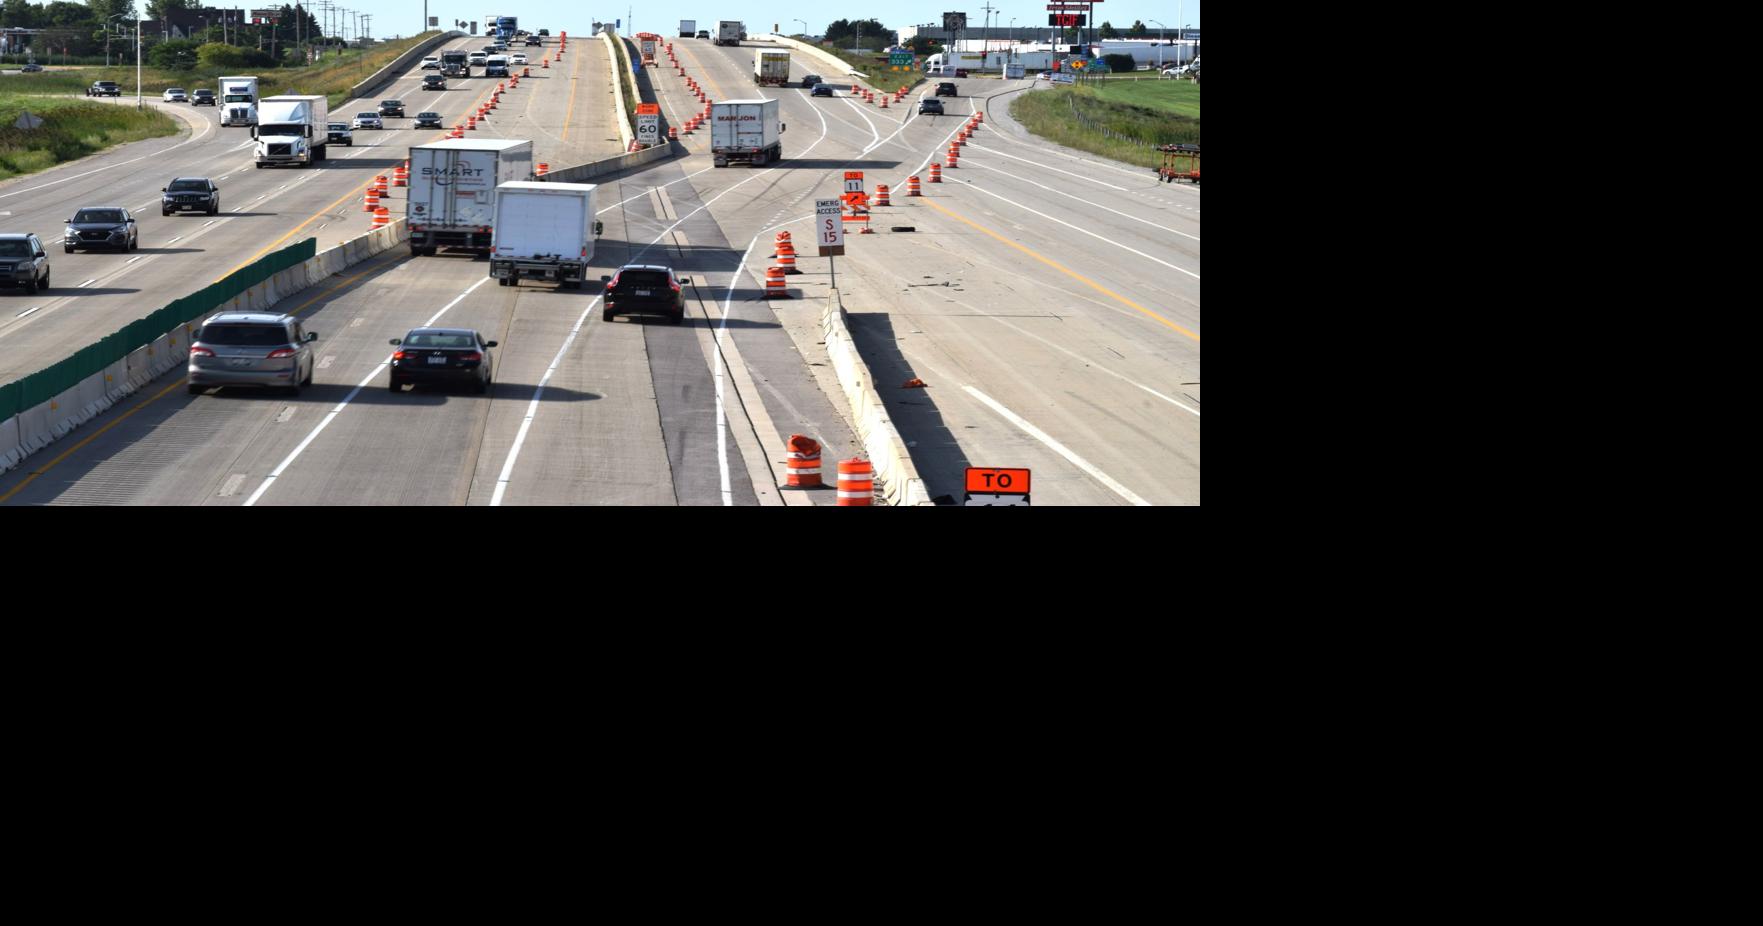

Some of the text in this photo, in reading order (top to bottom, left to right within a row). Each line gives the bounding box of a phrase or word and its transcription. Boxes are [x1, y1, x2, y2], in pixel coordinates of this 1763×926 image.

[639, 125, 657, 133] 60
[421, 167, 484, 177] SMART
[848, 182, 859, 191] 11
[816, 200, 840, 208] EMERG
[816, 207, 841, 215] ACCESS
[825, 219, 834, 231] S
[823, 231, 837, 243] 15
[981, 473, 1012, 488] TO
